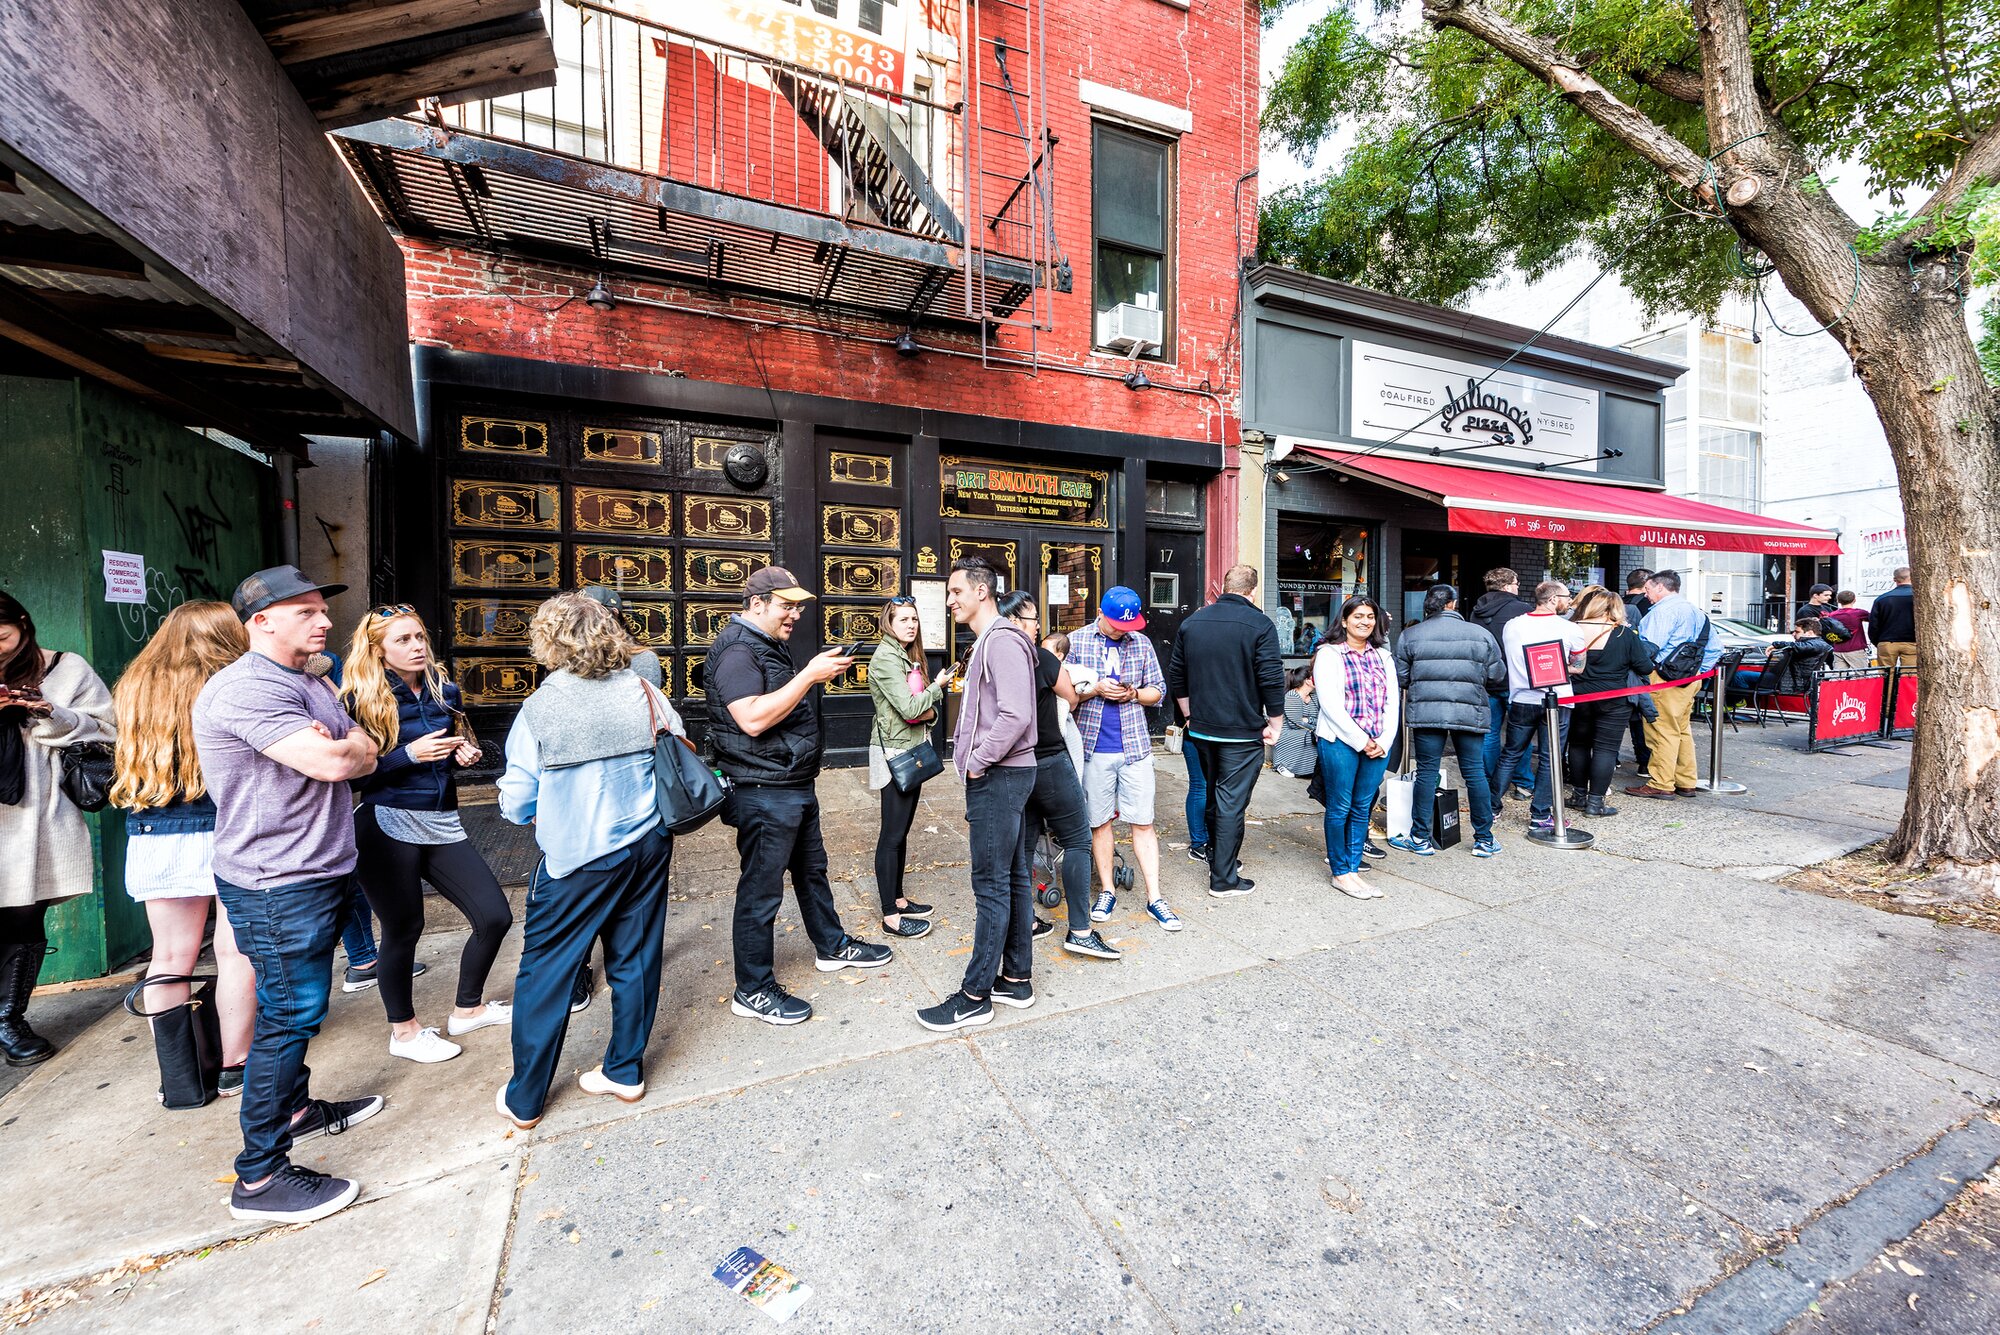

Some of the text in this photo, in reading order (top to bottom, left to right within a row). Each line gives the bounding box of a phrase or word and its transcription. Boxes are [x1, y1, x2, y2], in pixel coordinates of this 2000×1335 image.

[1380, 390, 1436, 406] COAL FIRED
[1467, 415, 1511, 433] PIZZA
[956, 471, 986, 489] ART
[988, 470, 1058, 496] SMOOTH
[973, 491, 989, 500] YORK
[1017, 495, 1029, 503] THE
[995, 503, 1028, 514] YESTERDAY
[1504, 517, 1517, 529] 718
[1527, 519, 1541, 531] 596
[1548, 520, 1566, 533] 6700
[1639, 530, 1706, 547] JULIANA'S
[1864, 529, 1906, 551] GRIMA
[1160, 549, 1174, 563] 17
[108, 560, 140, 569] RESIDENTIAL
[108, 569, 141, 578] COMMERCIAL
[113, 578, 138, 586] CLEANING
[1279, 582, 1306, 590] OUNDED
[1119, 608, 1135, 621] hi
